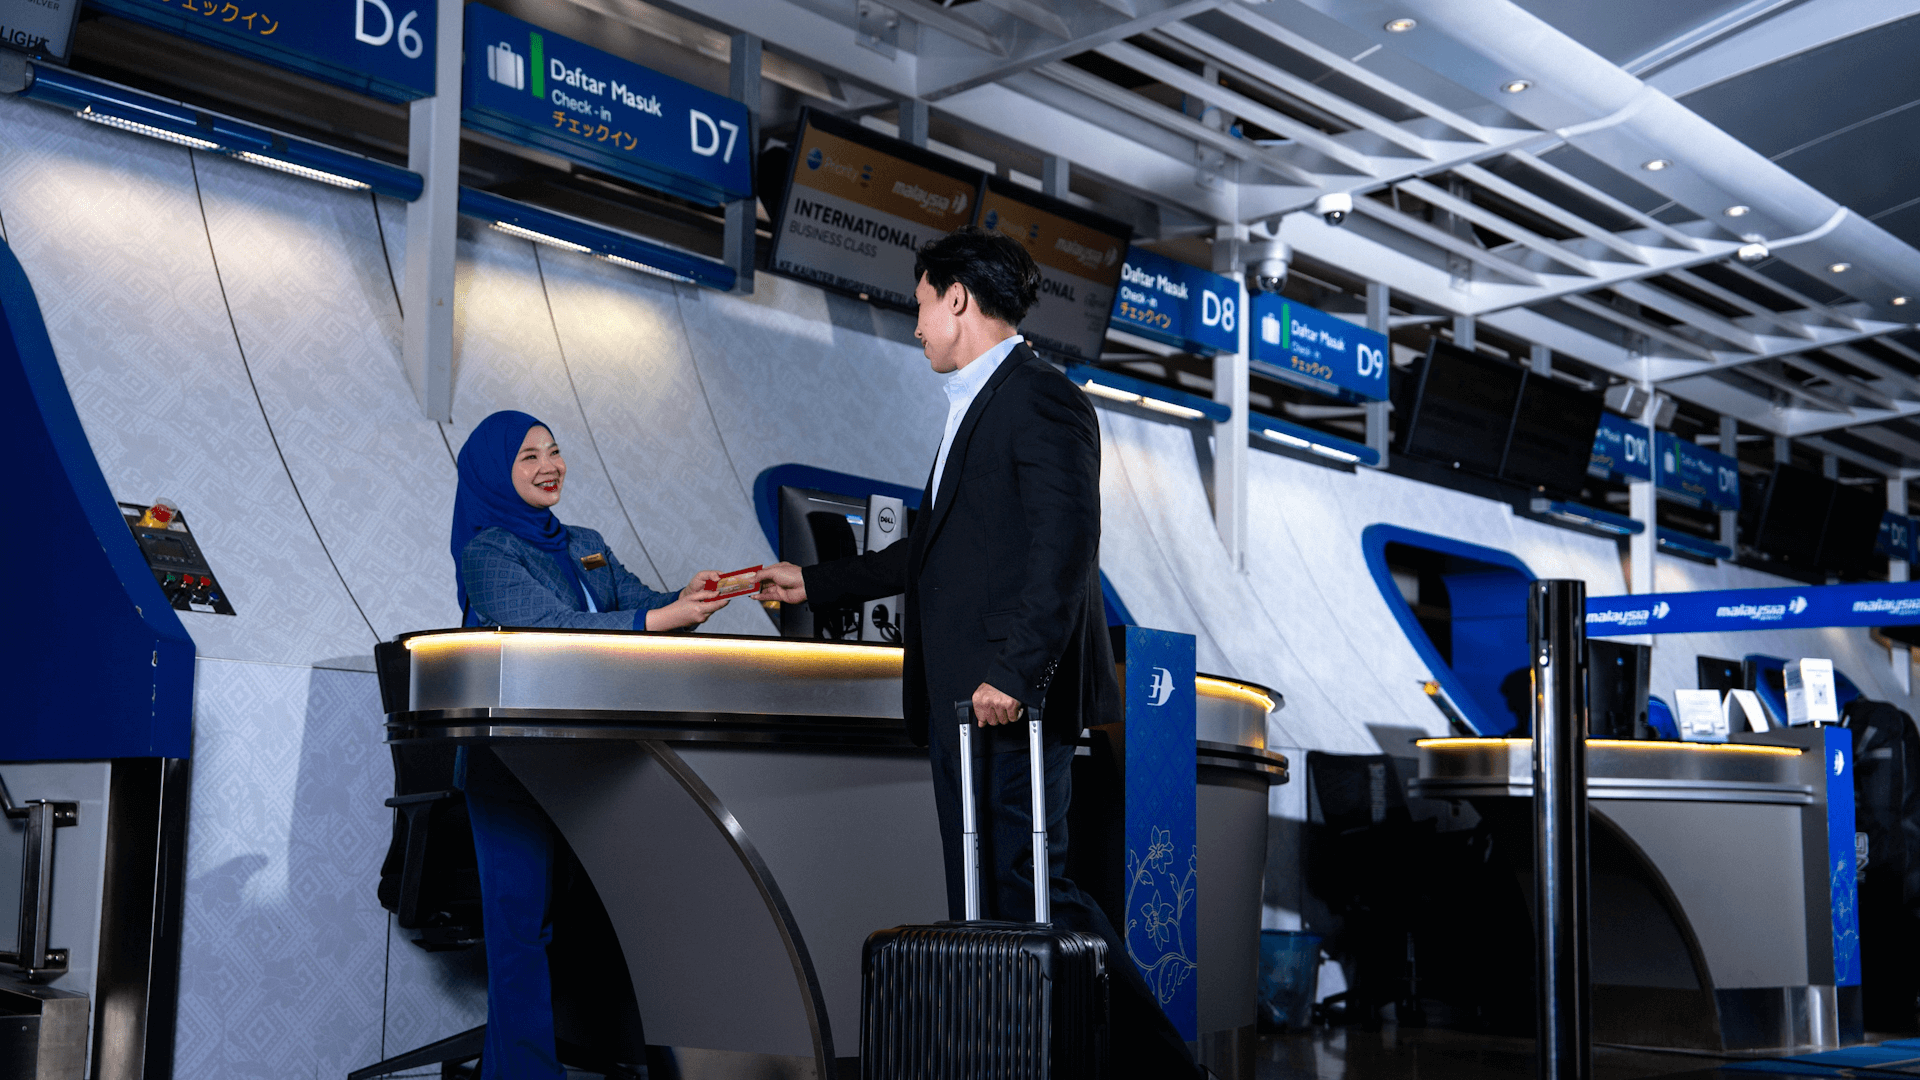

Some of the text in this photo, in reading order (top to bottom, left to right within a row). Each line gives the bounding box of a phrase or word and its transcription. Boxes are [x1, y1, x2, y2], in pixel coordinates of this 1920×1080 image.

[163, 0, 279, 35] ェックイン
[355, 0, 423, 59] D6
[550, 58, 663, 118] Daftar Masuk
[552, 110, 638, 151] チェックイン
[689, 108, 739, 164] D7
[789, 220, 878, 258] BUSINESS CLASS
[794, 197, 919, 252] INTERNATIONAL
[1121, 262, 1189, 300] Daftar Masuk
[1202, 289, 1235, 333] D8
[1357, 343, 1384, 380] D9
[880, 516, 894, 524] DELL
[1586, 609, 1650, 625] malaysia
[1716, 604, 1786, 619] malaysia
